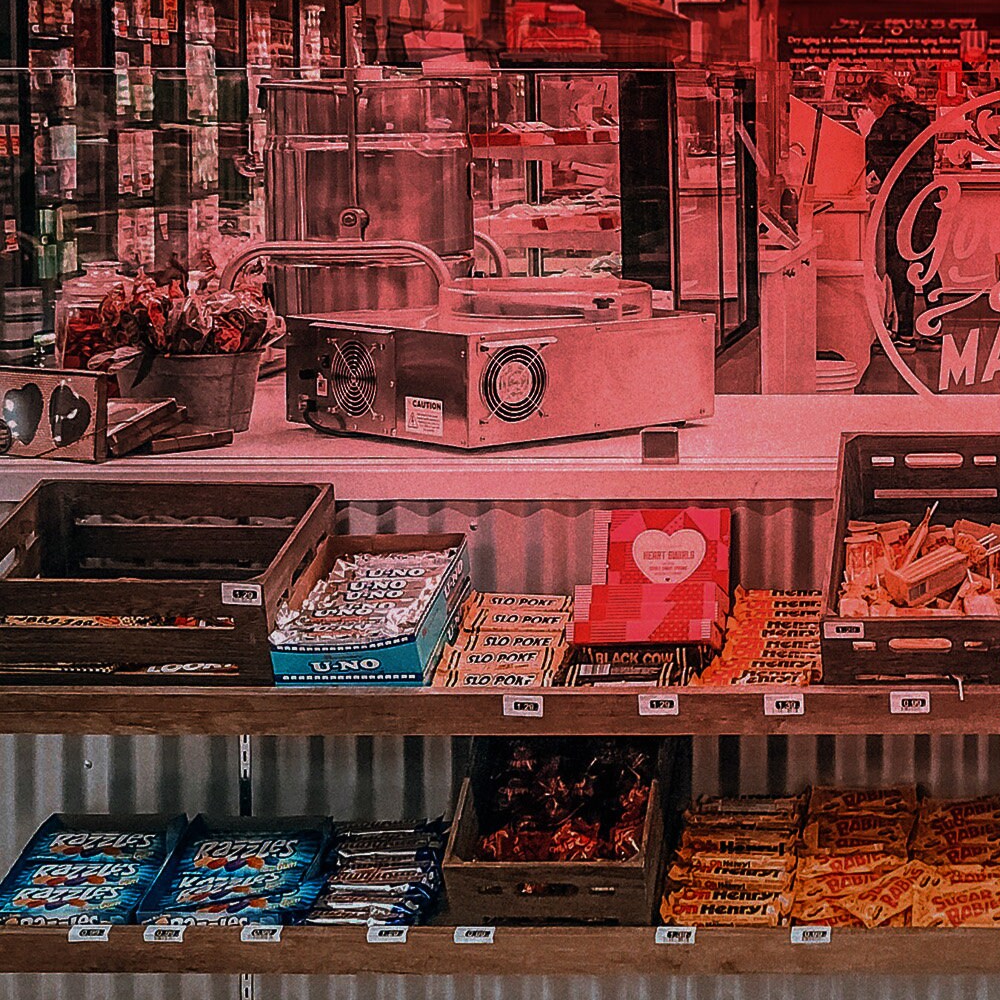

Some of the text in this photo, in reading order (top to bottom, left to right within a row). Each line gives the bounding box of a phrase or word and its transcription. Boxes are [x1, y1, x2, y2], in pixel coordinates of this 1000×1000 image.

[412, 399, 442, 411] CAUTION
[368, 568, 426, 578] U-NO
[349, 579, 407, 592] U-NO
[345, 589, 404, 601] U-NO
[490, 596, 517, 606] SLO
[493, 614, 519, 623] SLO
[483, 636, 553, 647] SLO POKE
[467, 653, 494, 664] SLO
[595, 652, 675, 664] BLACK COW
[309, 657, 381, 673] U-NO
[463, 675, 491, 686] SLO
[50, 832, 156, 850] Razzles
[193, 839, 299, 861] Razzles
[32, 863, 141, 879] Razzles
[13, 886, 125, 902] Razzles
[931, 889, 993, 911] SUGAR
[699, 904, 768, 915] Henry!
